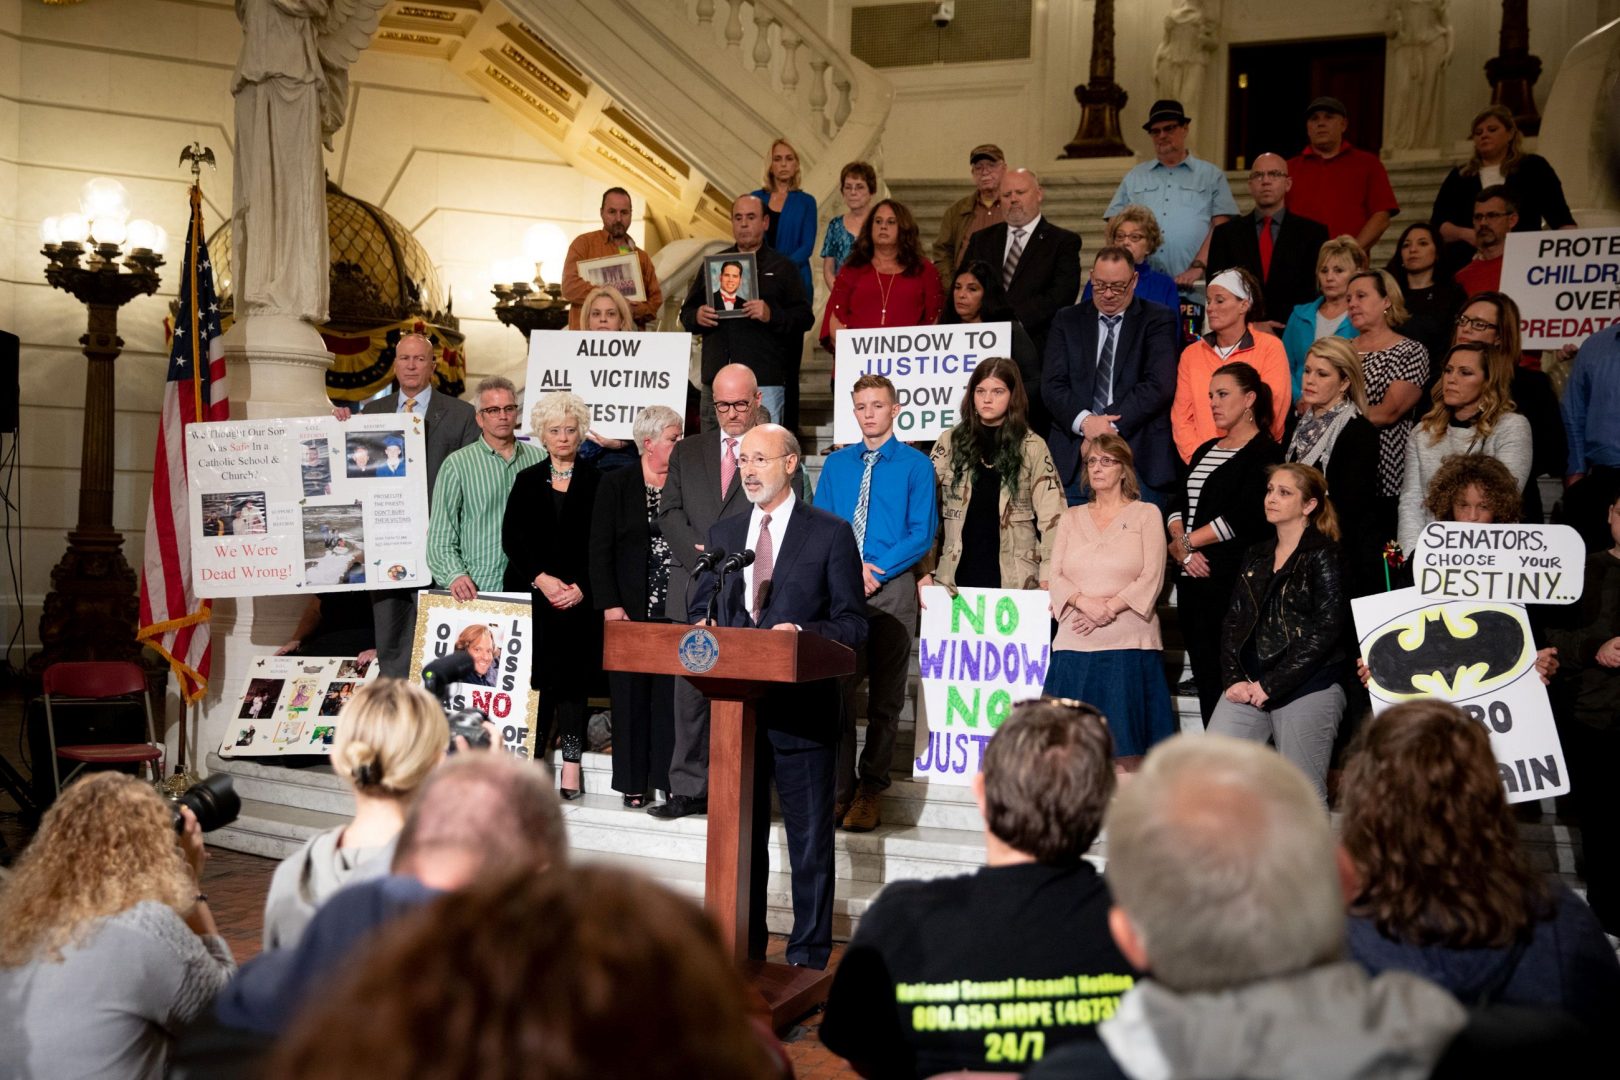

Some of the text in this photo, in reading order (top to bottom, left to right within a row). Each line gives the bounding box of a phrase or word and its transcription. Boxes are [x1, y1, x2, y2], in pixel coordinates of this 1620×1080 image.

[1538, 236, 1620, 258] PROTE
[1527, 263, 1619, 286] CHILDR
[1519, 316, 1620, 338] PREDAT
[576, 339, 641, 357] ALLOW
[852, 330, 997, 355] WINDOW TO
[860, 354, 978, 377] JUSTICE
[541, 369, 671, 389] ALL VICTIMS
[896, 386, 953, 407] DOW
[586, 403, 645, 424] ESTI
[897, 409, 955, 430] OPE
[191, 430, 206, 440] We
[247, 427, 266, 437] Our
[267, 425, 285, 436] Son
[229, 442, 250, 452] Safe
[252, 442, 262, 451] In
[198, 454, 280, 468] Catholic School &
[1423, 522, 1549, 552] SENATORS,
[214, 543, 278, 558] We Were
[1425, 553, 1563, 569] CHOOSE YOUR
[200, 564, 293, 581] Dead Wrong!
[1420, 568, 1577, 601] DESTINY...
[951, 594, 1020, 636] NO
[434, 623, 451, 658] OU
[502, 620, 522, 692] LOSS
[920, 638, 1049, 686] WINDOW
[441, 690, 512, 718] AS NO
[946, 686, 1014, 730] NO
[1461, 700, 1513, 735] RO
[502, 725, 529, 744] OF
[915, 731, 992, 774] JUST
[983, 1031, 1046, 1063] 24/7
